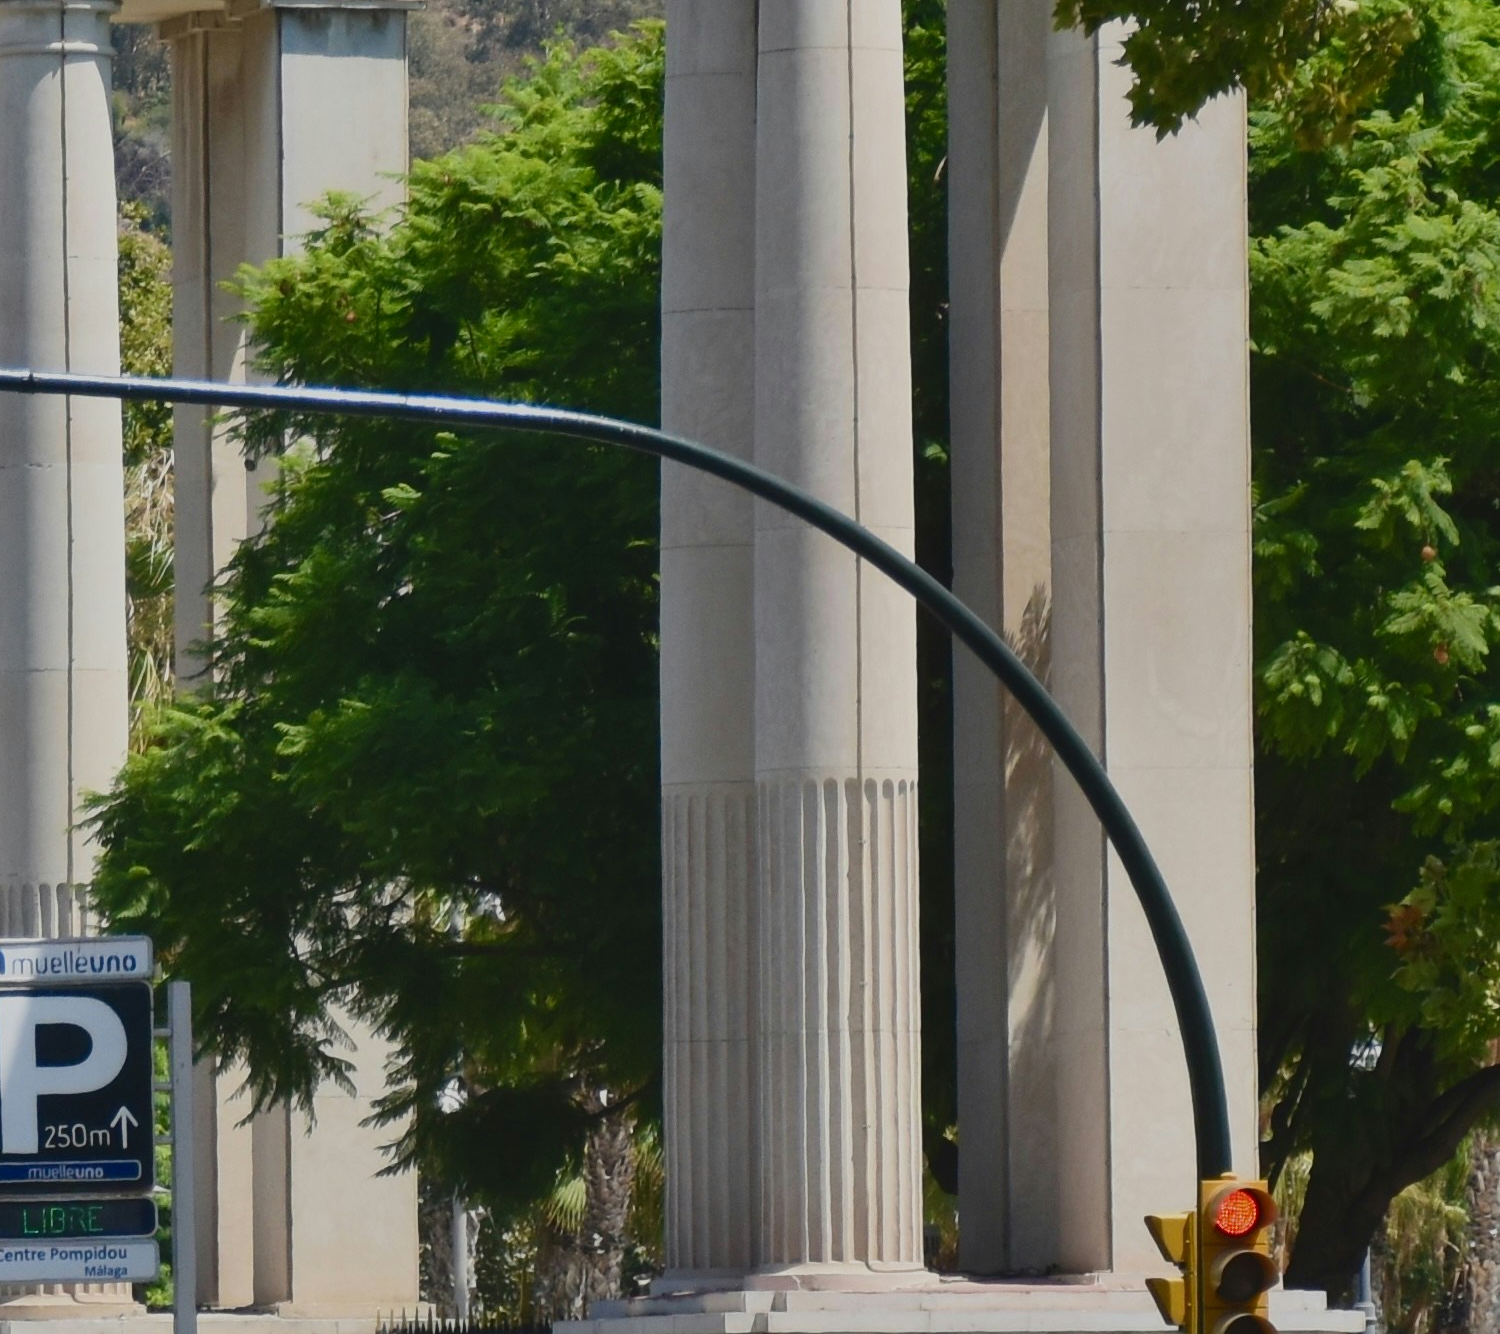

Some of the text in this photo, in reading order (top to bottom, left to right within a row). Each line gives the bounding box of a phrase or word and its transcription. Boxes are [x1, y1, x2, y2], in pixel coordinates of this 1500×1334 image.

[44, 1123, 112, 1149] 250m
[28, 1165, 104, 1180] muelleuno
[23, 1206, 104, 1234] LIBRE
[50, 1247, 128, 1265] Pompidou
[84, 1264, 128, 1279] Málaga
